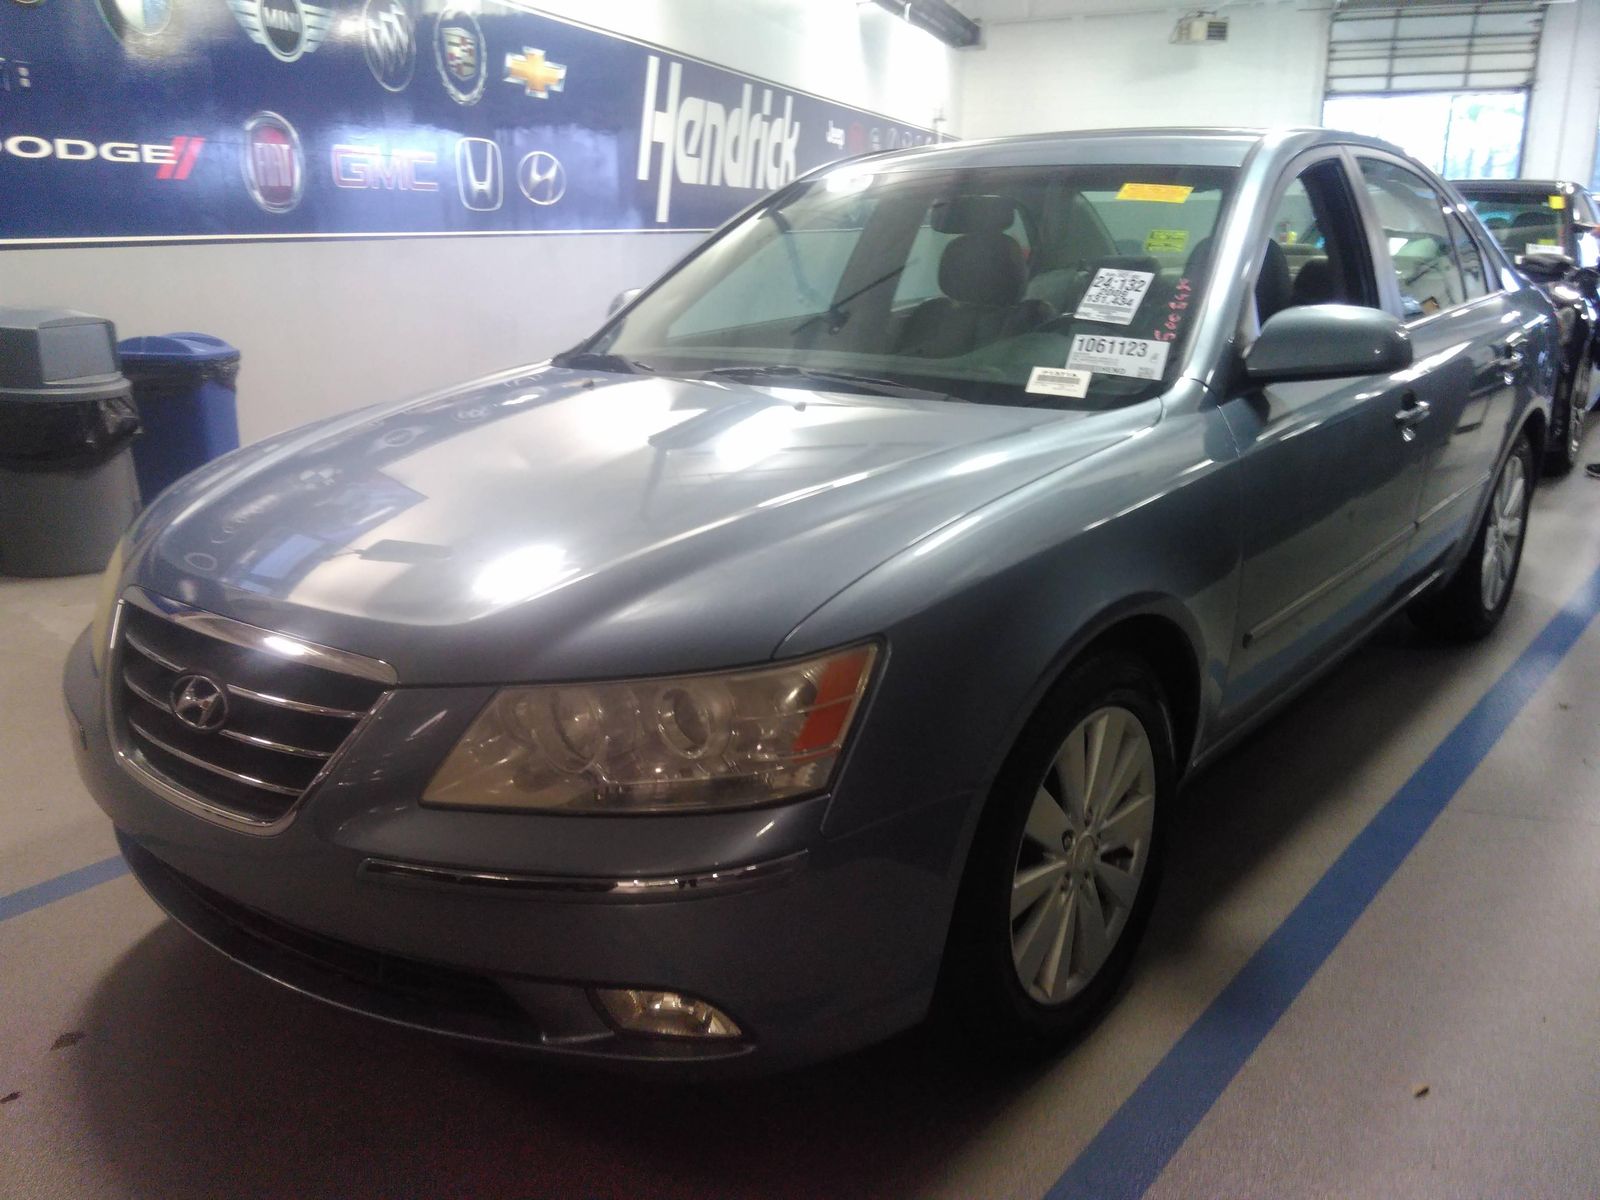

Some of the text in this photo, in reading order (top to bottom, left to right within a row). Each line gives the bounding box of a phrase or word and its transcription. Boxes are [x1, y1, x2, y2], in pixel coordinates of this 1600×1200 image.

[0, 135, 178, 164] ODGE
[636, 55, 801, 223] Hendrick
[331, 144, 438, 192] GMC
[1077, 337, 1149, 358] 1061123
